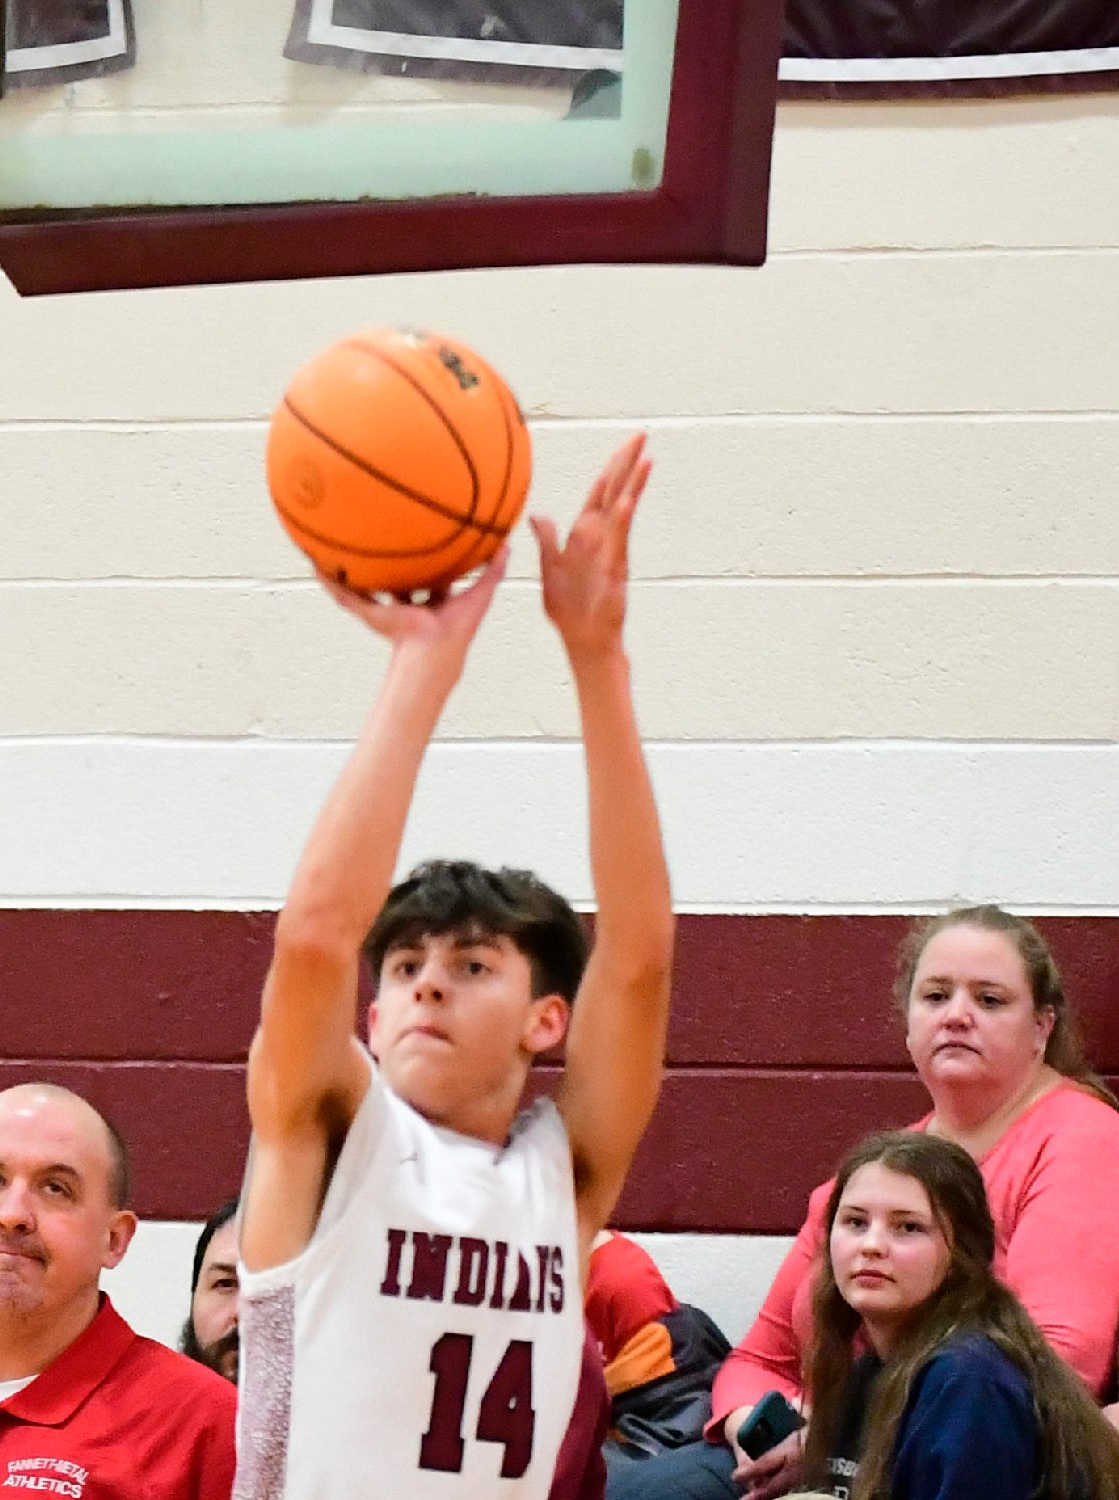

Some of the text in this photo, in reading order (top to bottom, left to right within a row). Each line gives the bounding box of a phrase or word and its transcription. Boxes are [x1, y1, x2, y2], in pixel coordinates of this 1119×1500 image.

[380, 1228, 564, 1314] INDIANS
[418, 1332, 536, 1479] 14
[2, 1474, 82, 1498] ATHLETICS
